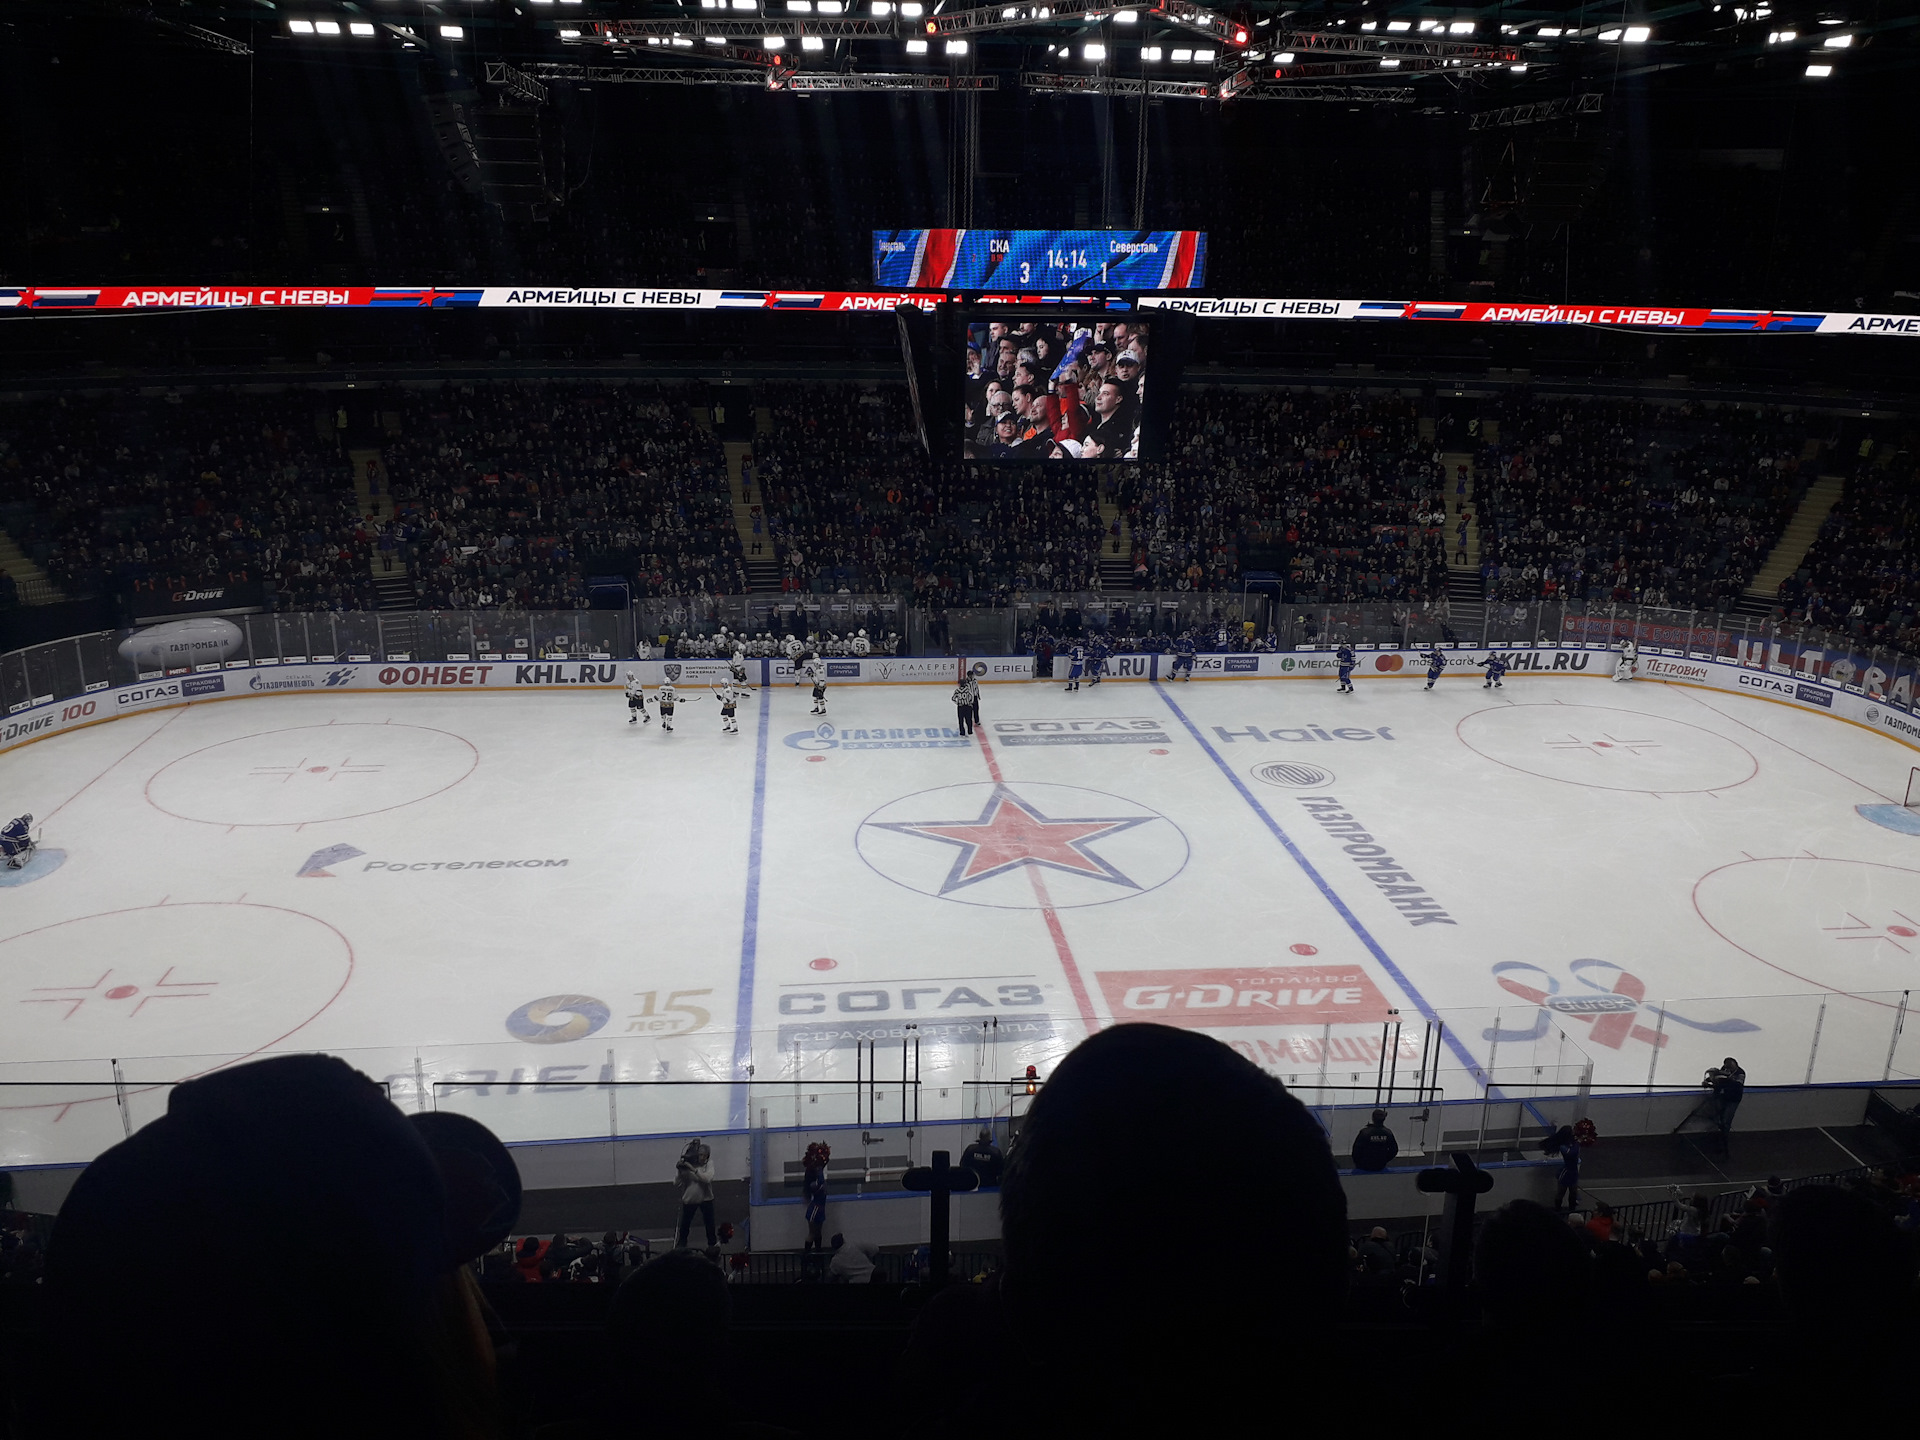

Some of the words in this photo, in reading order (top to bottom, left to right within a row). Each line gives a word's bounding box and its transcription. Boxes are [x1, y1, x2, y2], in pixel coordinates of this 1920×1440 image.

[989, 239, 1010, 254] СКА
[1109, 239, 1159, 255] Северсталь
[1047, 249, 1088, 269] 14:14
[1019, 261, 1031, 284] 3
[1061, 273, 1069, 288] 2
[1100, 261, 1108, 284] 1
[122, 287, 252, 307] АРМЕЙЦЫ
[260, 290, 275, 305] С
[281, 290, 349, 305] НЕВЫ
[506, 289, 616, 306] АРМЕЙЦЫ
[623, 291, 637, 305] С
[641, 291, 701, 305] НЕВЫ
[1263, 302, 1277, 314] С
[1281, 302, 1341, 315] НЕВЫ
[1481, 305, 1591, 326] АРМЕЙЦЫ
[1599, 309, 1614, 324] С
[1616, 309, 1686, 325] НЕВЫ
[901, 663, 955, 671] ГАЛЕРЕЯ
[1409, 656, 1474, 666] masrcard
[1499, 652, 1590, 671] KHL.RU
[378, 666, 493, 685] ФОНБЕТ
[515, 664, 617, 684] KHL.RU
[184, 678, 222, 688] СТРАХОВАЯ
[190, 684, 216, 692] ГРУППА
[1739, 675, 1794, 694] СОГАЗ
[118, 685, 179, 704] СОГАЗ
[661, 691, 673, 701] 28
[1803, 692, 1825, 703] ГРУППА
[62, 700, 96, 722] 100
[841, 726, 961, 741] ГАЗПРОМ
[993, 720, 1161, 732] СОГАЗ
[1210, 724, 1396, 743] Haier
[362, 859, 569, 873] Ростелеком
[1296, 796, 1458, 927] ГАЗПРОМБАНК
[1234, 975, 1358, 986] ТОПЛИВО
[778, 984, 1045, 1015] СОГАЗ
[1555, 997, 1629, 1012] durex
[627, 988, 713, 1040] 15
[625, 1017, 686, 1034] лет
[793, 1026, 937, 1042] СТРАХОВАЯ
[939, 1022, 1041, 1036] ГРУППА
